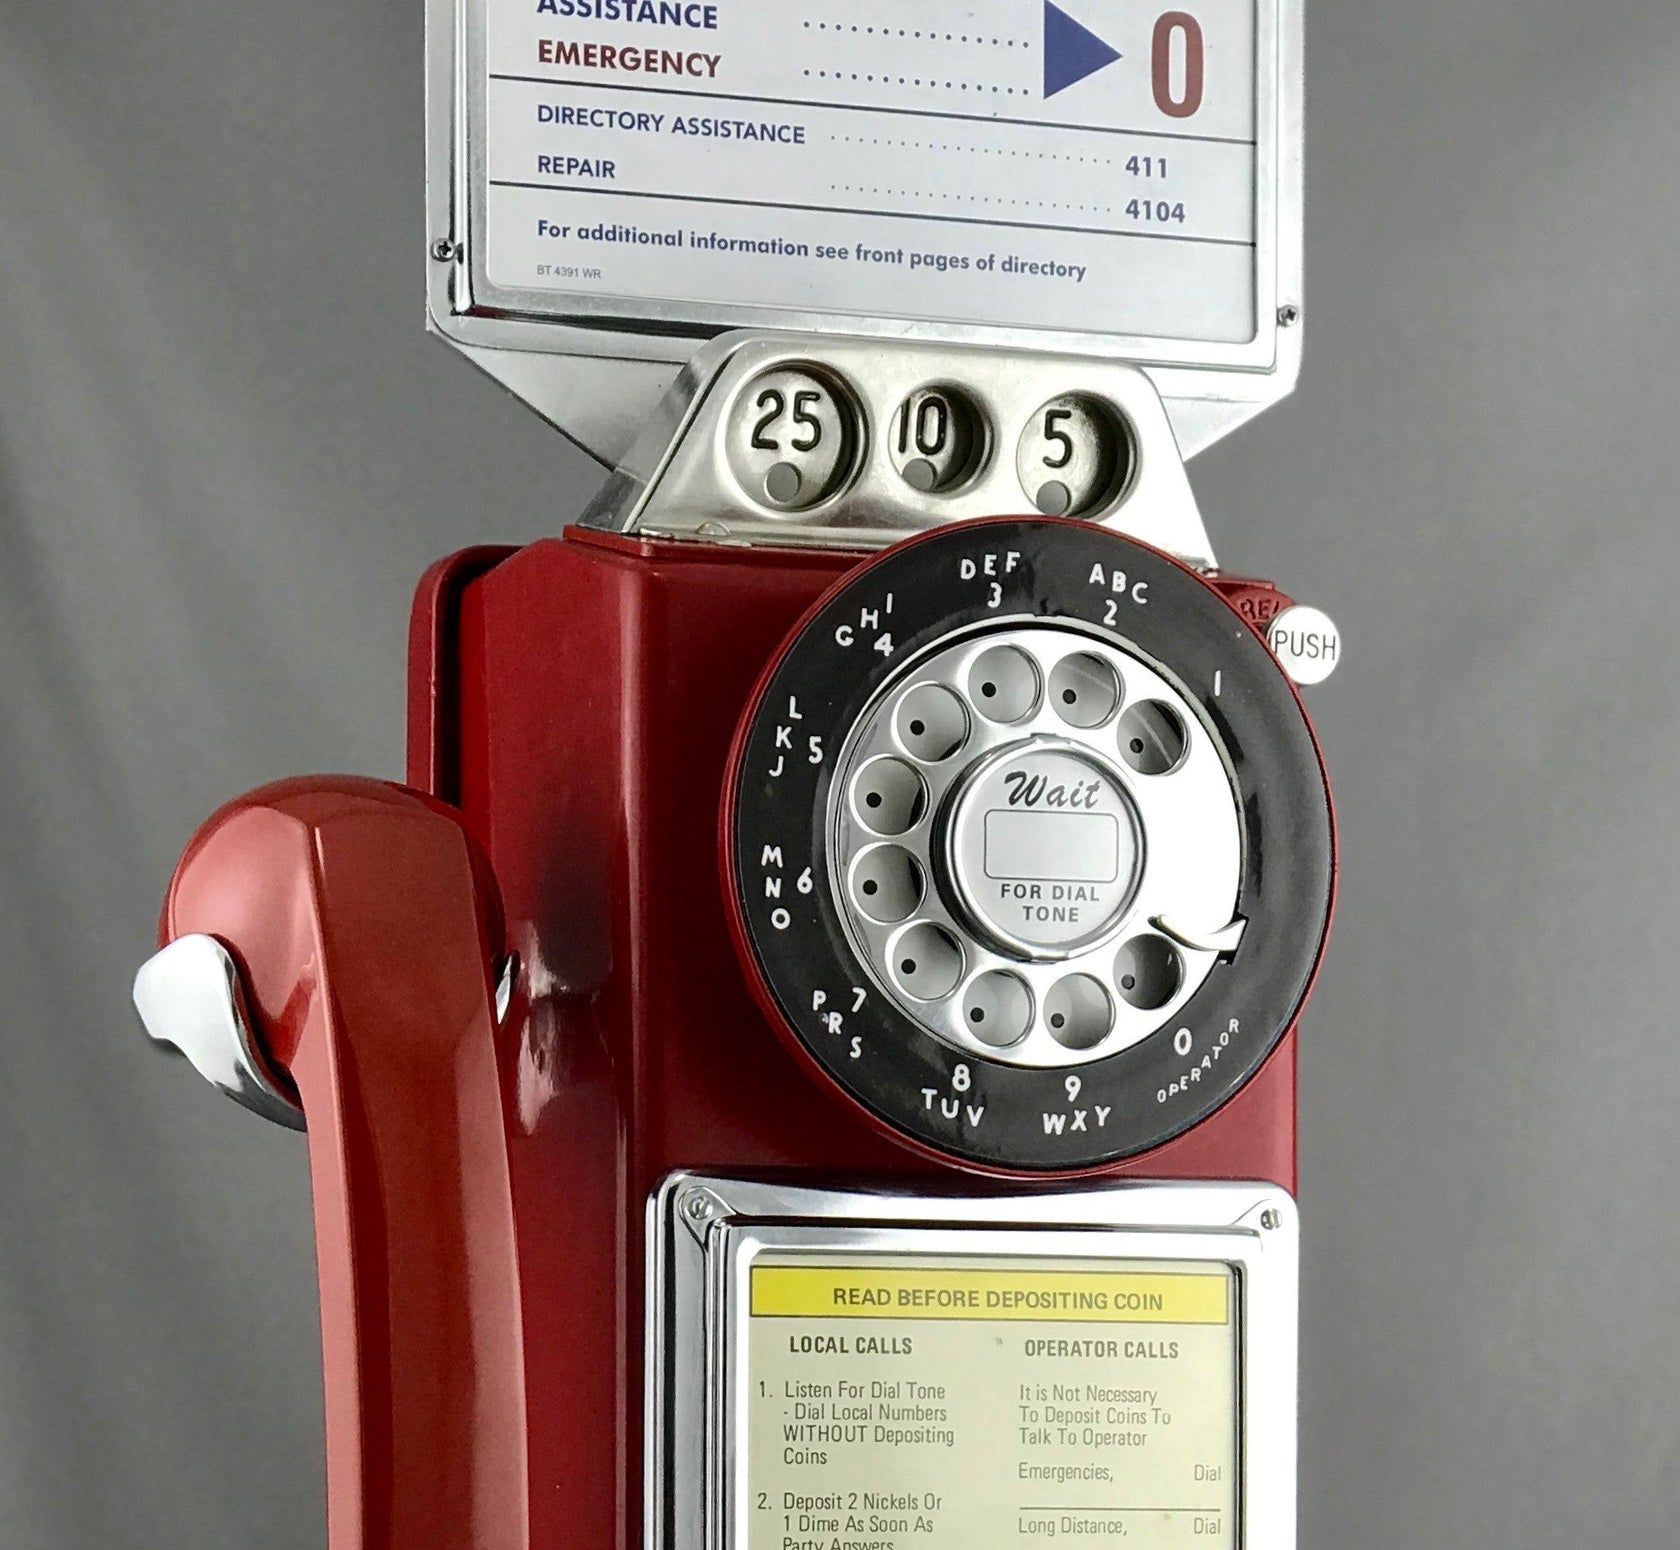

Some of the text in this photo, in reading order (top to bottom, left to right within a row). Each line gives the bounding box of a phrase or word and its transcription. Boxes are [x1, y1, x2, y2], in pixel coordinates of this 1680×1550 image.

[536, 0, 718, 29] ASSISTANCE
[537, 38, 722, 78] EMERGENCY
[1149, 9, 1204, 119] 0
[537, 104, 1168, 179] DIRECTORY ASSISTANCE 411
[537, 154, 1186, 223] REPAIR 4104
[537, 219, 1087, 282] For additional information see front pages of directory
[536, 264, 602, 279] BT 4391 WR
[750, 388, 822, 453] 25
[897, 395, 948, 456] 10
[1042, 408, 1072, 469] 5
[959, 551, 1021, 580] DEF
[986, 581, 1002, 608] 3
[1088, 562, 1149, 605] ABC
[1102, 599, 1118, 626] 2
[873, 631, 895, 657] 4
[1273, 629, 1337, 661] PUSH
[807, 735, 824, 764] 5
[1003, 770, 1101, 809] Wait
[796, 866, 814, 895] 6
[1000, 883, 1100, 901] FOR DIAL
[1022, 905, 1080, 923] TONE
[850, 986, 868, 1013] 7
[1156, 1017, 1241, 1104] OPERATOR
[951, 1063, 972, 1092] 8
[1064, 1074, 1082, 1103] 9
[920, 1087, 985, 1128] TUV
[1042, 1104, 1112, 1136] WXY
[833, 1287, 1164, 1311] READ BEFORE DEPOSITING COIN
[789, 1335, 913, 1356] LOCAL CALLS
[1024, 1339, 1180, 1360] OPERATOR CALLS
[759, 1380, 946, 1400] 1. Listen For Dial Tone
[1019, 1384, 1157, 1407] It is Not Necessary
[794, 1404, 825, 1421] Dial
[832, 1404, 873, 1421] Local
[879, 1404, 948, 1422] Numbers
[1019, 1406, 1172, 1428] To Deposit Coins To
[782, 1425, 955, 1448] WITHOUT Depositing
[1019, 1428, 1148, 1450] Talk To Operator
[783, 1447, 828, 1466] Coins
[1018, 1462, 1222, 1484] Emergencies, Dial
[757, 1493, 942, 1514] 2. Deposit 2 Nickels Or
[782, 1515, 934, 1534] 1 Dime As Soon As
[1018, 1517, 1222, 1538] Long Distance, Dial
